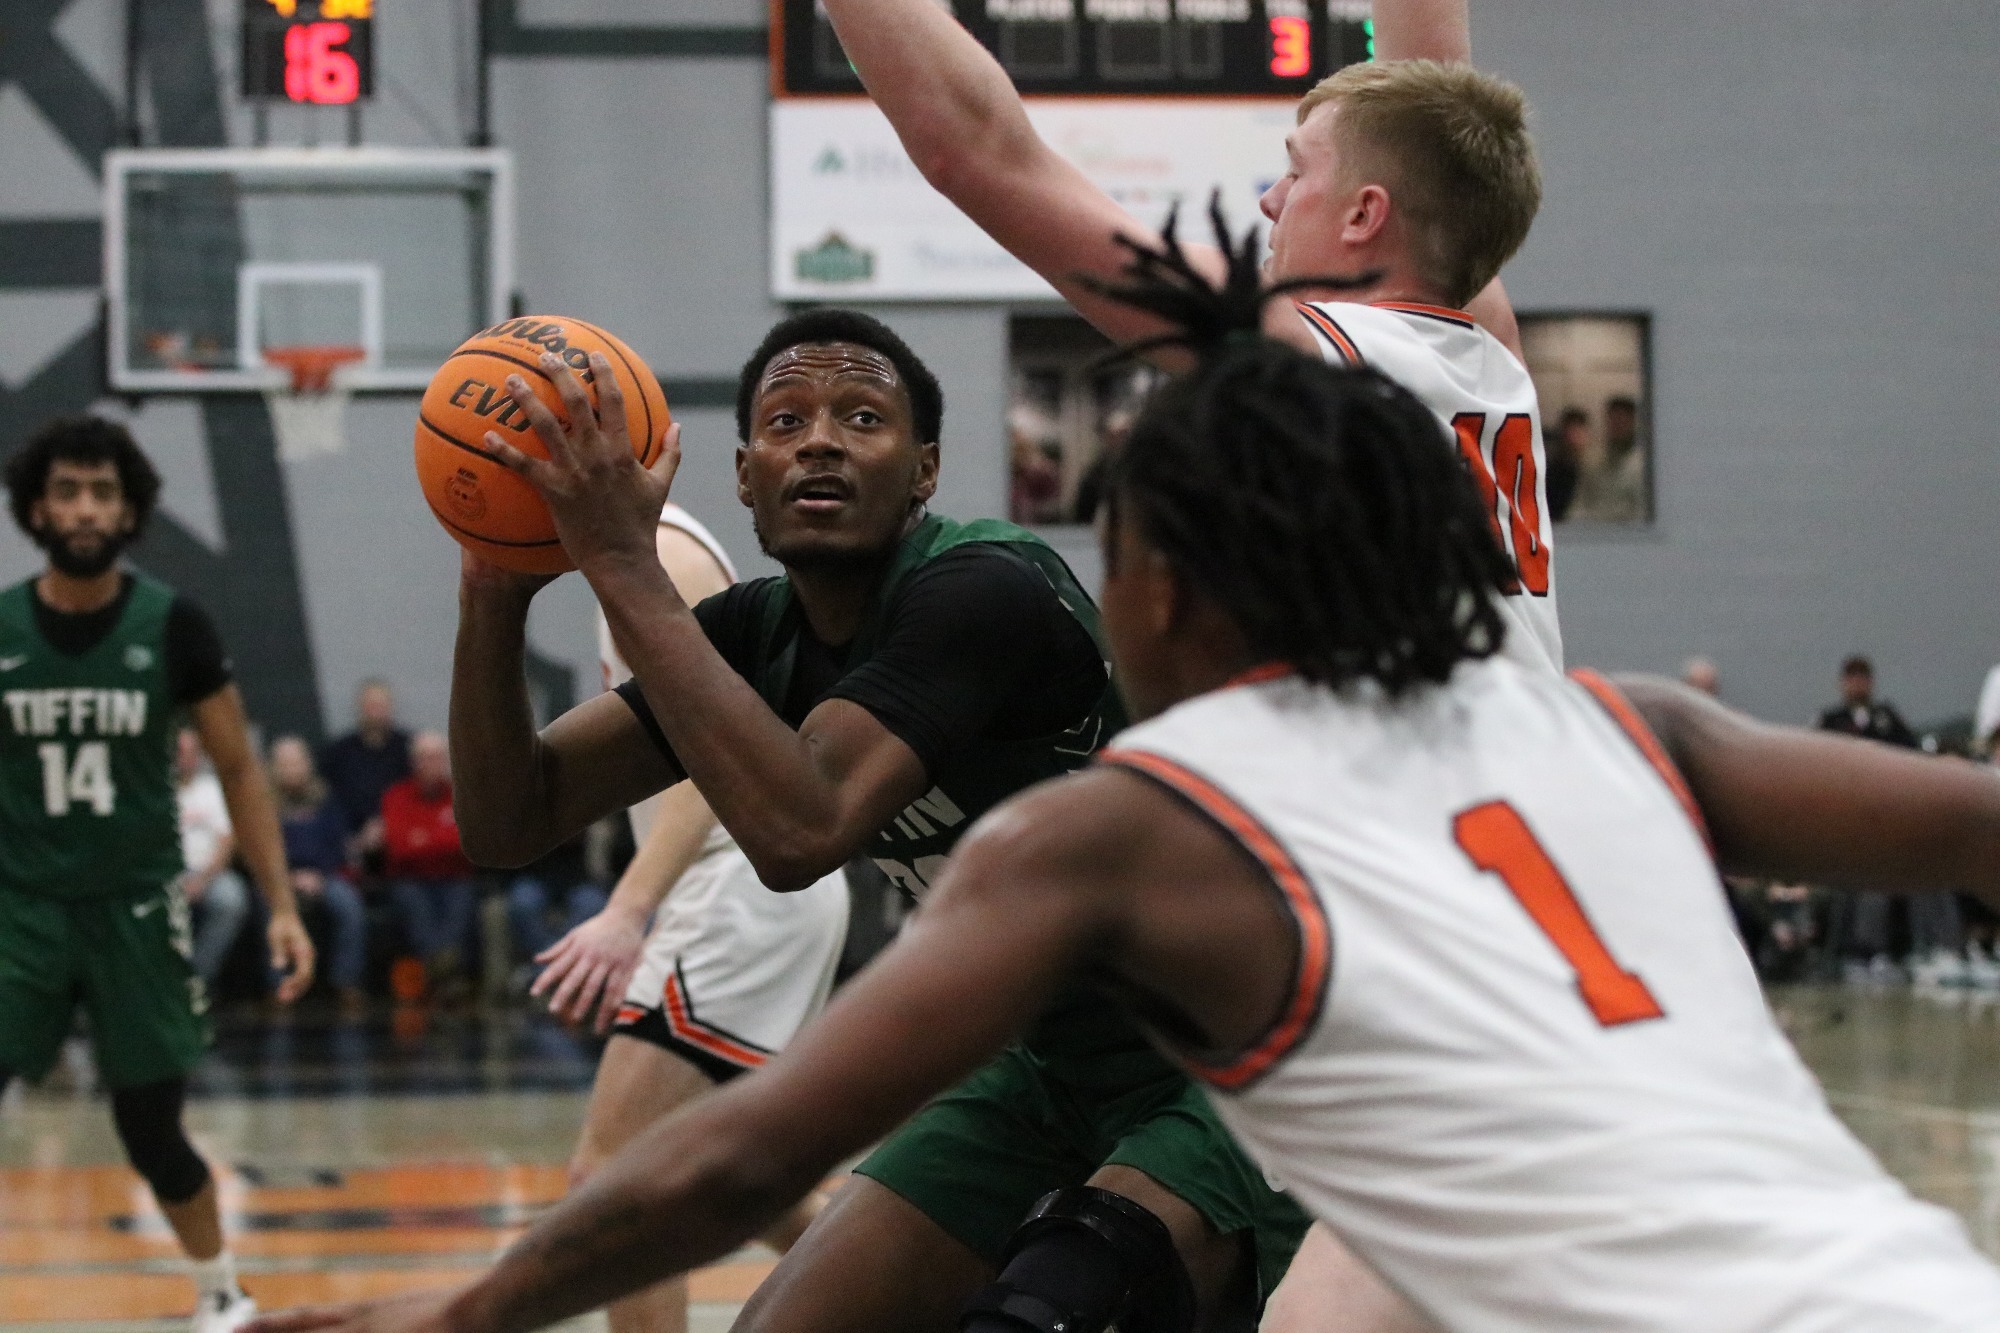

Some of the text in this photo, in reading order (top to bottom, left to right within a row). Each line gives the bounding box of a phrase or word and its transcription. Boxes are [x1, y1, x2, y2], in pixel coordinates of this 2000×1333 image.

[284, 22, 360, 105] 16
[1269, 16, 1310, 77] 3
[474, 319, 596, 385] Wilso
[4, 687, 147, 736] TIFFIN
[38, 741, 115, 817] 14
[1452, 798, 1664, 1028] 1
